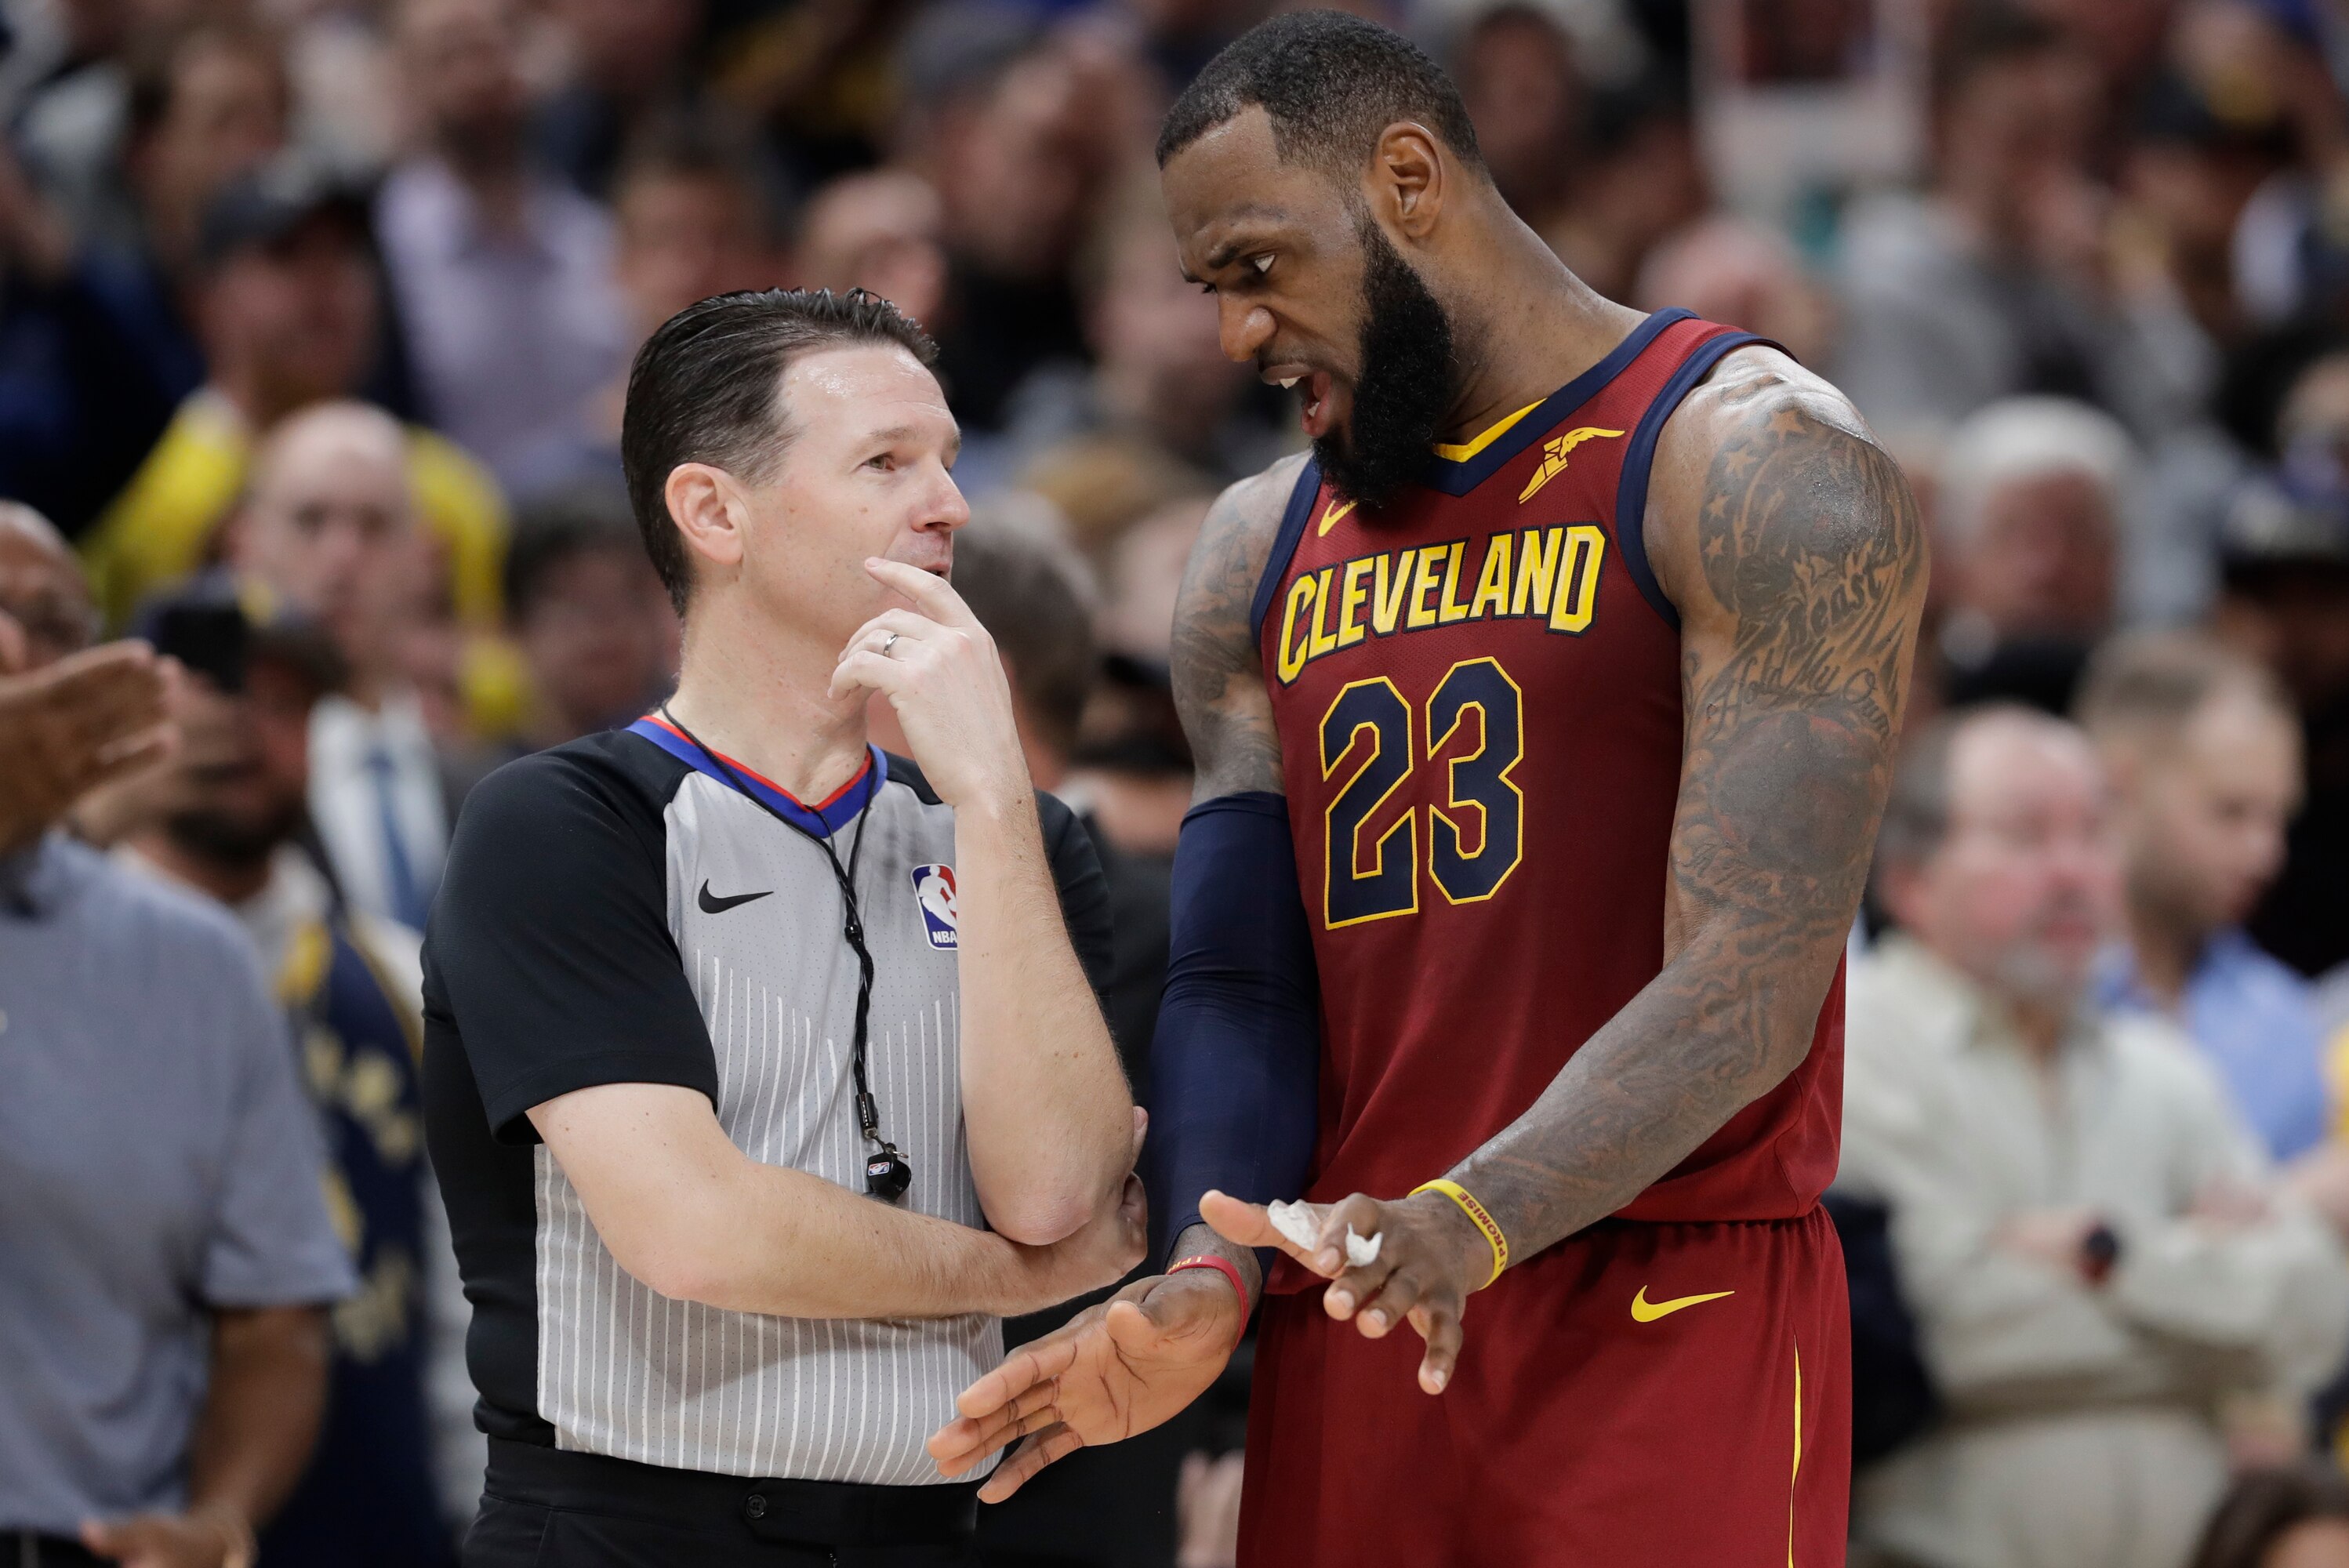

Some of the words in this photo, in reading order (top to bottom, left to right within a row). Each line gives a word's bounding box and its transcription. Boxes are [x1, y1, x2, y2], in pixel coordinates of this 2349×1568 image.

[1276, 522, 1608, 688] CLEVELAND
[1320, 656, 1523, 931] 23
[931, 931, 958, 944] NBA
[1457, 1191, 1506, 1257] PROMISE
